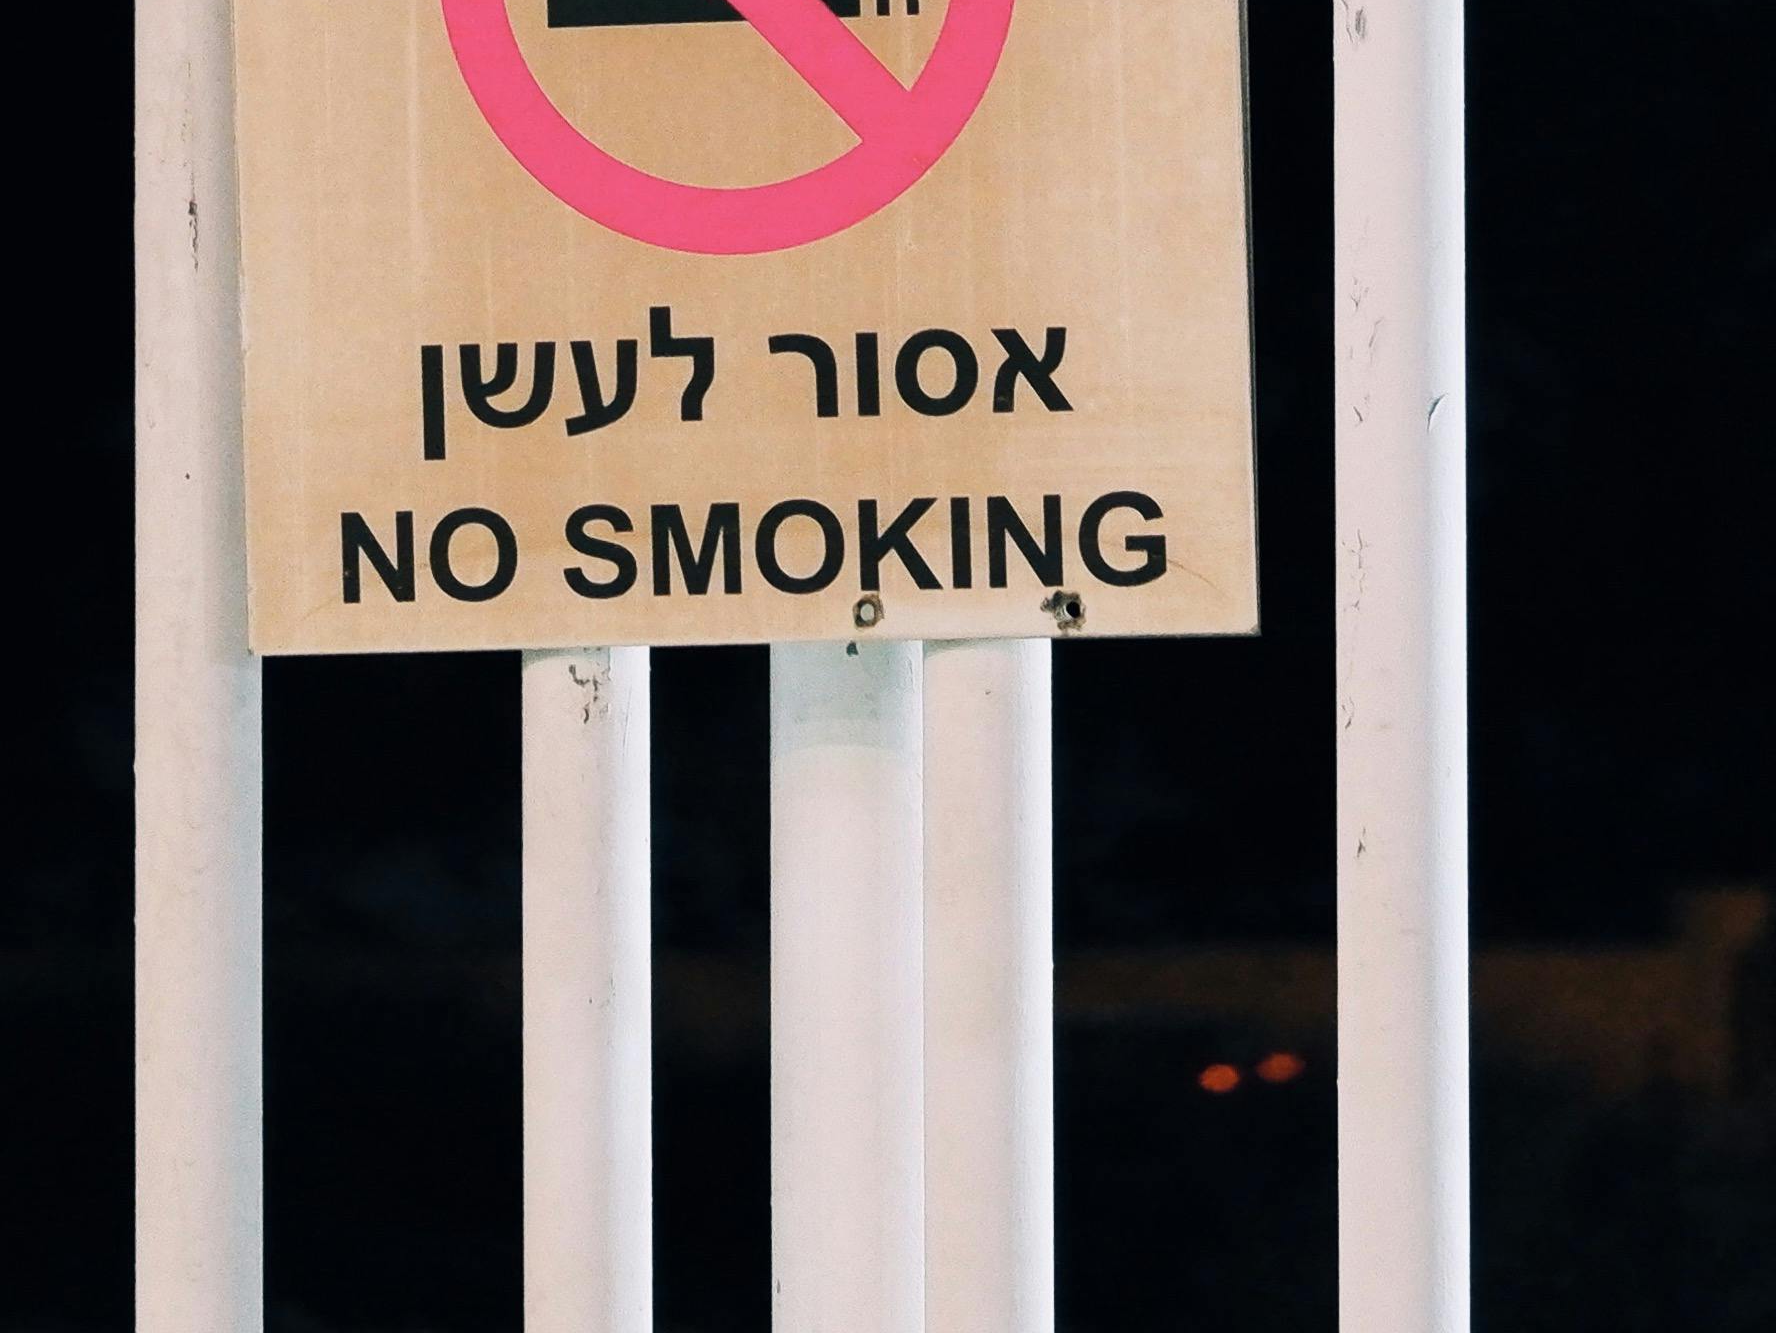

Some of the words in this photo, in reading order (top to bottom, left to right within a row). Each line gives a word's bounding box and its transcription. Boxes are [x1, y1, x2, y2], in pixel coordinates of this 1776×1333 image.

[420, 305, 716, 462] לעשן
[767, 326, 1075, 419] אסור
[339, 506, 519, 605] NO
[562, 489, 1168, 601] SMOKING
